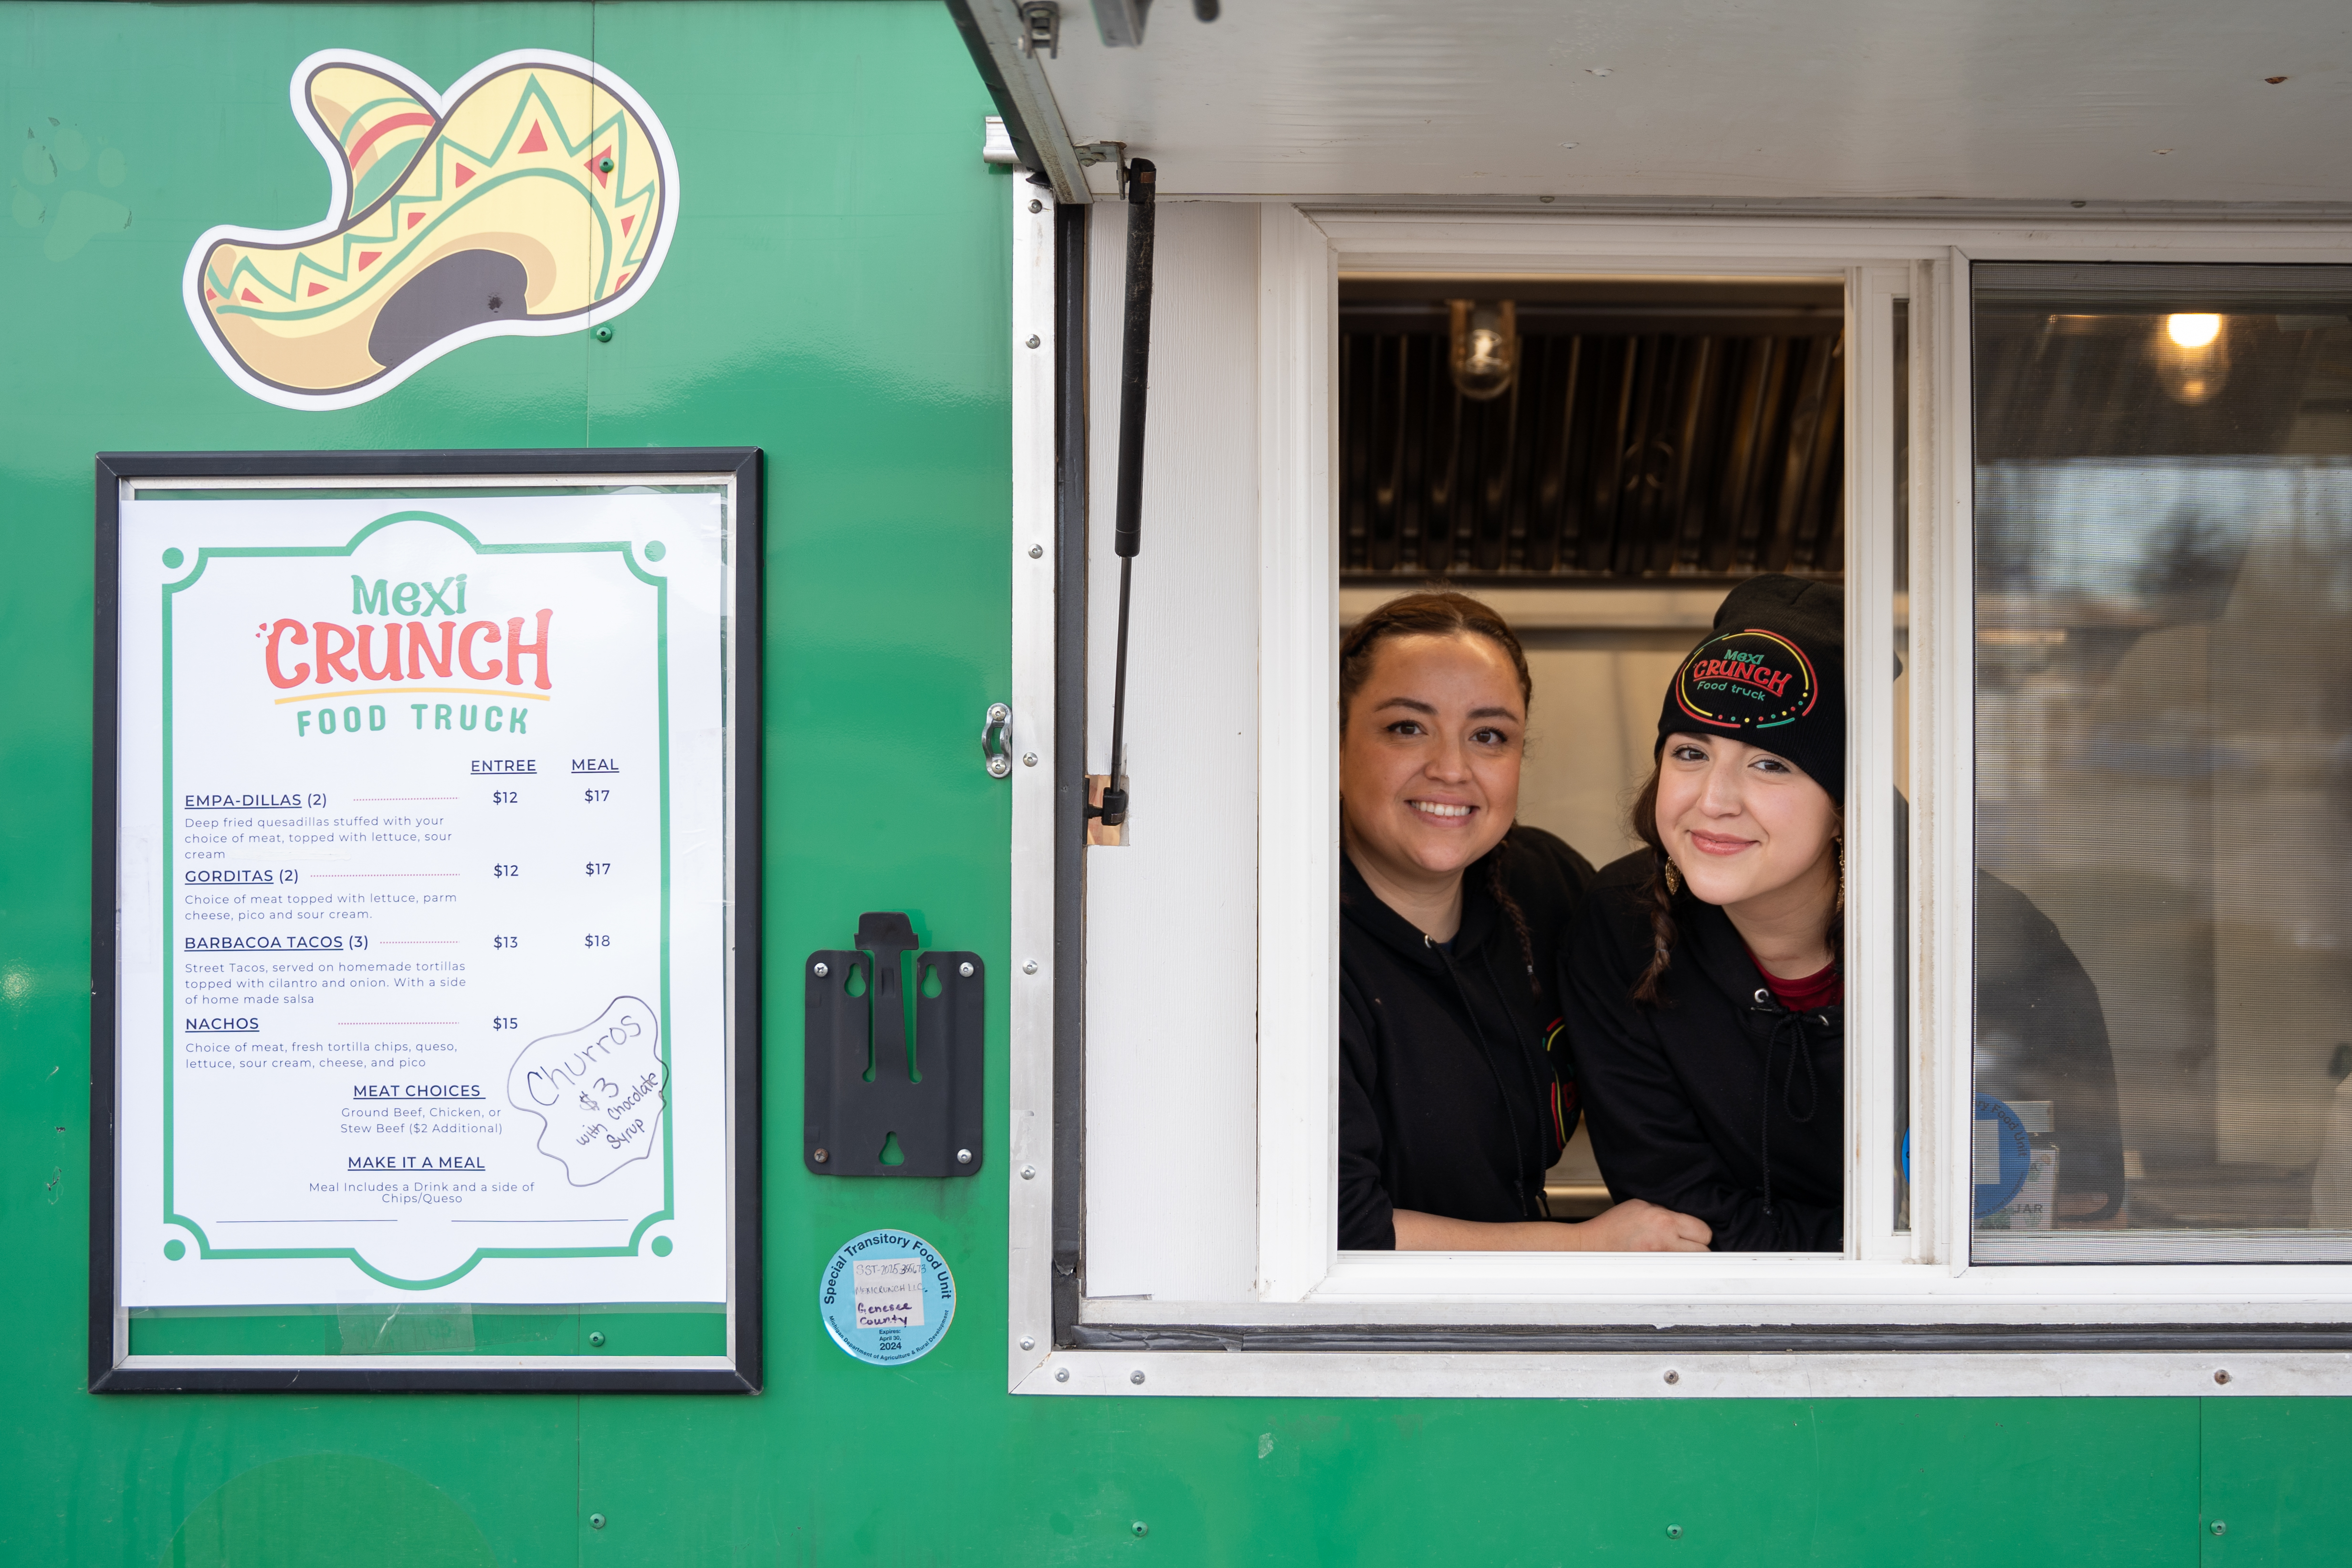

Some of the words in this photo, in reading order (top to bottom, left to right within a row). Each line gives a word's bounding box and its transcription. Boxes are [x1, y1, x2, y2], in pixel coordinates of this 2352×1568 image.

[351, 574, 467, 617] Mexi
[266, 609, 553, 689] CRUNCH
[1694, 659, 1792, 694] CRUNCH
[1697, 681, 1728, 690] Food
[1732, 684, 1765, 701] truck
[297, 705, 385, 737] FOOD
[411, 704, 528, 734] TRUCK
[472, 759, 536, 772] ENTREE
[571, 758, 620, 771] MEAL
[185, 794, 301, 807] EMPA-DILLAS
[308, 793, 326, 809] (2)
[493, 789, 518, 806] $12
[584, 788, 610, 804] $17
[185, 818, 219, 830] Deep
[223, 817, 252, 827] fried
[257, 817, 329, 829] quesadillas
[334, 816, 378, 826] stuffed
[383, 816, 411, 826] with
[415, 818, 444, 828] your
[185, 833, 227, 843] choice
[231, 833, 245, 843] of
[249, 834, 284, 844] meat,
[289, 832, 334, 844] topped
[338, 832, 367, 842] with
[372, 831, 420, 842] lettuce,
[185, 851, 225, 859] cream
[185, 870, 273, 883] GORDITAS
[279, 869, 298, 884] (2)
[494, 863, 519, 879] $12
[585, 861, 611, 877] $17
[185, 894, 229, 905] Choice
[234, 894, 247, 904] of
[251, 895, 283, 904] meat
[287, 894, 332, 905] topped
[337, 893, 365, 903] with
[370, 893, 419, 904] lettuce,
[424, 894, 456, 905] parm
[185, 910, 233, 921] cheese,
[239, 910, 265, 922] pico
[269, 909, 293, 919] and
[185, 936, 282, 949] BARBACOA
[286, 936, 343, 948] TACOS
[349, 935, 368, 951] (3)
[493, 934, 518, 950] $13
[584, 933, 610, 949] $18
[185, 963, 225, 973] Street
[229, 963, 268, 974] Tacos,
[273, 962, 314, 972] served
[339, 961, 411, 972] homemade
[416, 961, 465, 971] tortillas
[185, 979, 231, 990] topped
[236, 978, 264, 988] with
[269, 978, 317, 988] cilantro
[322, 978, 345, 988] and
[350, 978, 389, 988] onion.
[394, 977, 424, 987] With
[440, 977, 466, 987] side
[185, 994, 198, 1004] of
[202, 994, 239, 1004] home
[244, 994, 279, 1004] made
[284, 994, 314, 1004] salsa
[186, 1017, 259, 1030] NACHOS
[493, 1015, 518, 1031] $15
[186, 1042, 230, 1052] Choice
[235, 1042, 248, 1052] of
[252, 1043, 287, 1053] meat,
[292, 1042, 323, 1052] fresh
[327, 1042, 369, 1052] tortilla
[374, 1041, 411, 1053] chips,
[416, 1043, 457, 1053] queso,
[186, 1059, 235, 1070] lettuce,
[272, 1060, 315, 1069] cream,
[319, 1057, 367, 1069] cheese,
[371, 1057, 394, 1067] and
[399, 1057, 426, 1069] pico
[527, 1015, 641, 1106] Churros
[354, 1085, 400, 1097] MEAT
[405, 1084, 481, 1097] CHOICES
[341, 1107, 388, 1117] Ground
[394, 1107, 425, 1118] Beef,
[430, 1107, 484, 1118] Chicken,
[341, 1124, 372, 1133] Stew
[377, 1123, 405, 1133] Beef
[410, 1122, 428, 1135] ($2
[432, 1123, 502, 1135] Additional)
[576, 1123, 608, 1146] with
[348, 1156, 396, 1168] MAKE
[402, 1156, 417, 1168] IT
[421, 1156, 433, 1168] A
[439, 1156, 485, 1168] MEAL
[310, 1182, 339, 1192] Meal
[344, 1182, 399, 1192] Includes
[414, 1182, 449, 1191] Drink
[453, 1182, 476, 1191] and
[492, 1182, 518, 1192] side
[522, 1182, 535, 1192] of
[382, 1192, 462, 1205] Chips/Queso
[2013, 1203, 2043, 1213] JAR
[824, 1255, 847, 1304] Special
[844, 1233, 910, 1257] Transitory
[912, 1241, 943, 1270] Food
[937, 1271, 952, 1299] Unit
[860, 1315, 908, 1327] County
[829, 1315, 844, 1338] Michigan
[843, 1337, 872, 1358] Department
[916, 1341, 930, 1352] Rural
[929, 1310, 949, 1342] Development
[880, 1342, 902, 1350] 2024
